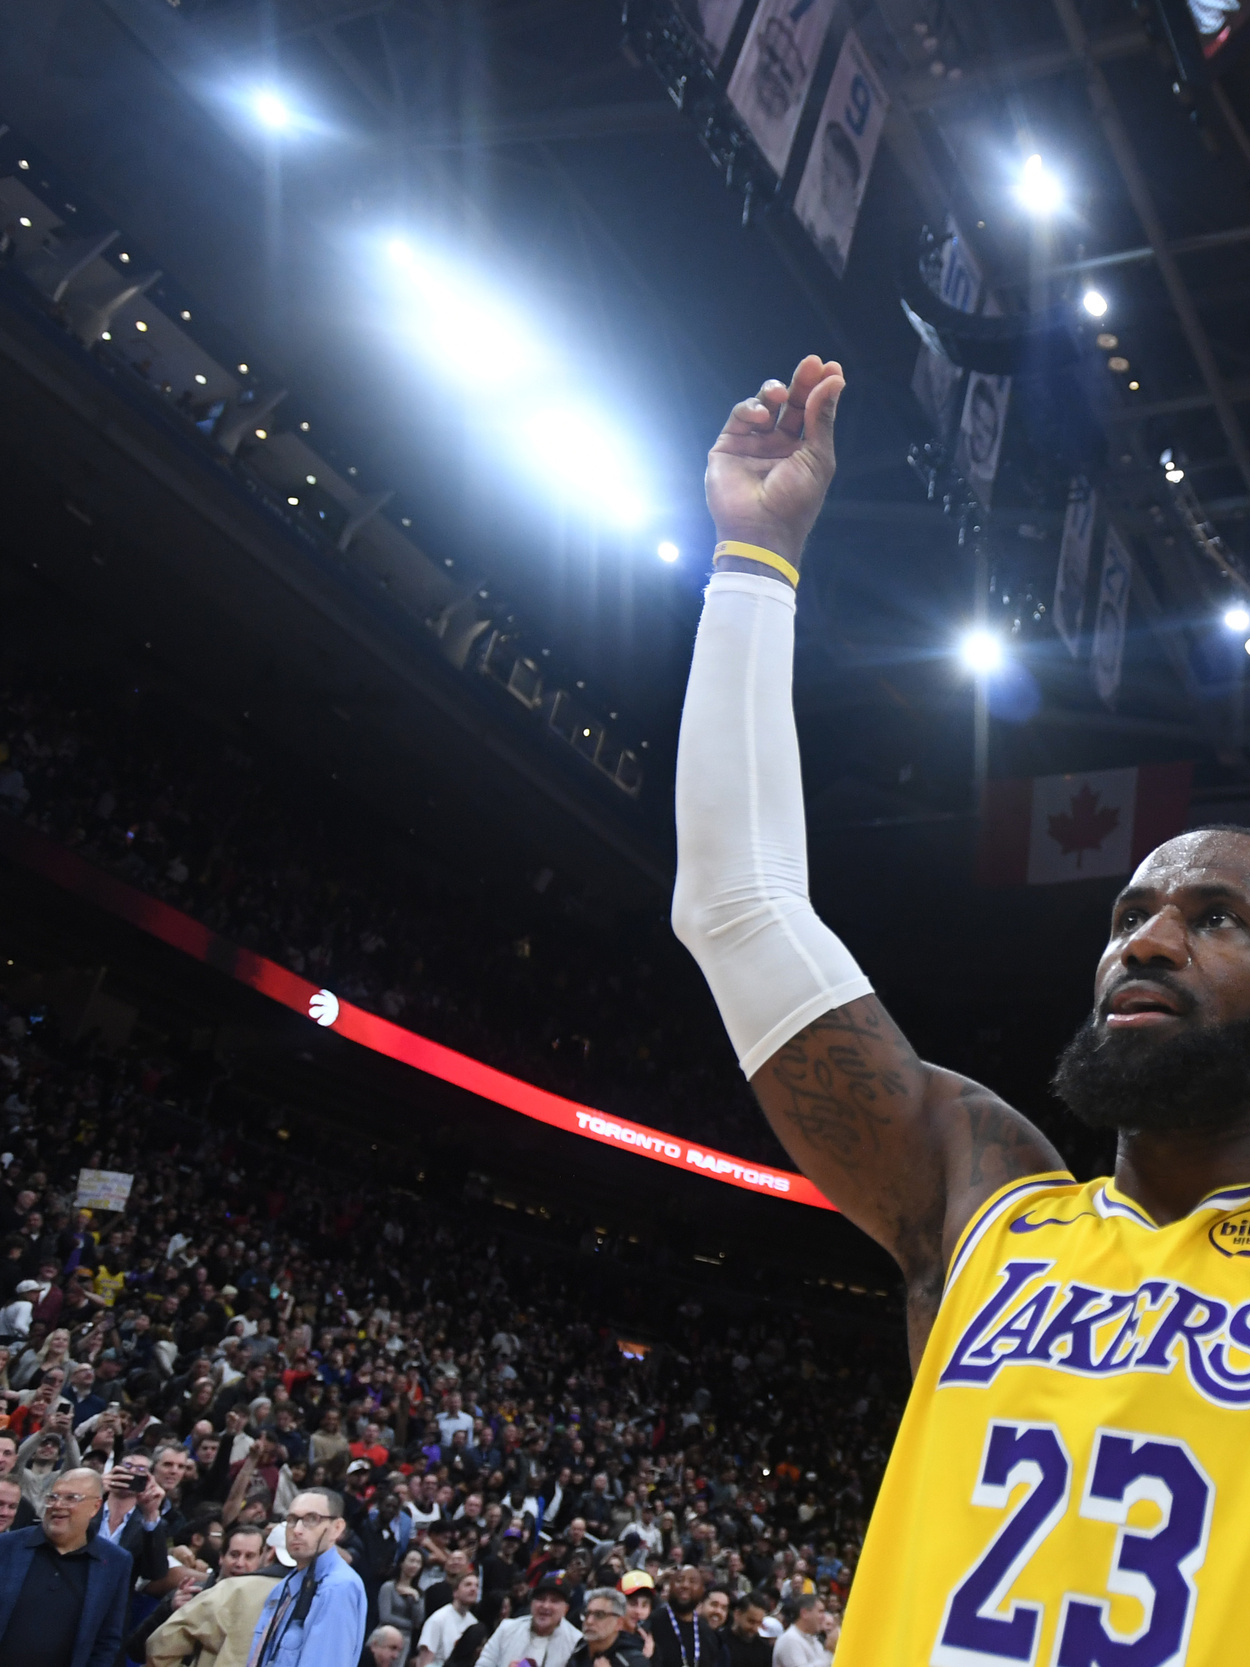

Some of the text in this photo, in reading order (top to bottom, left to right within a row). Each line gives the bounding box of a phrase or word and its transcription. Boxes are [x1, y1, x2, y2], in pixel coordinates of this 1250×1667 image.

[576, 1111, 790, 1192] TORONTO RAPTORS
[929, 1417, 1217, 1667] 23
